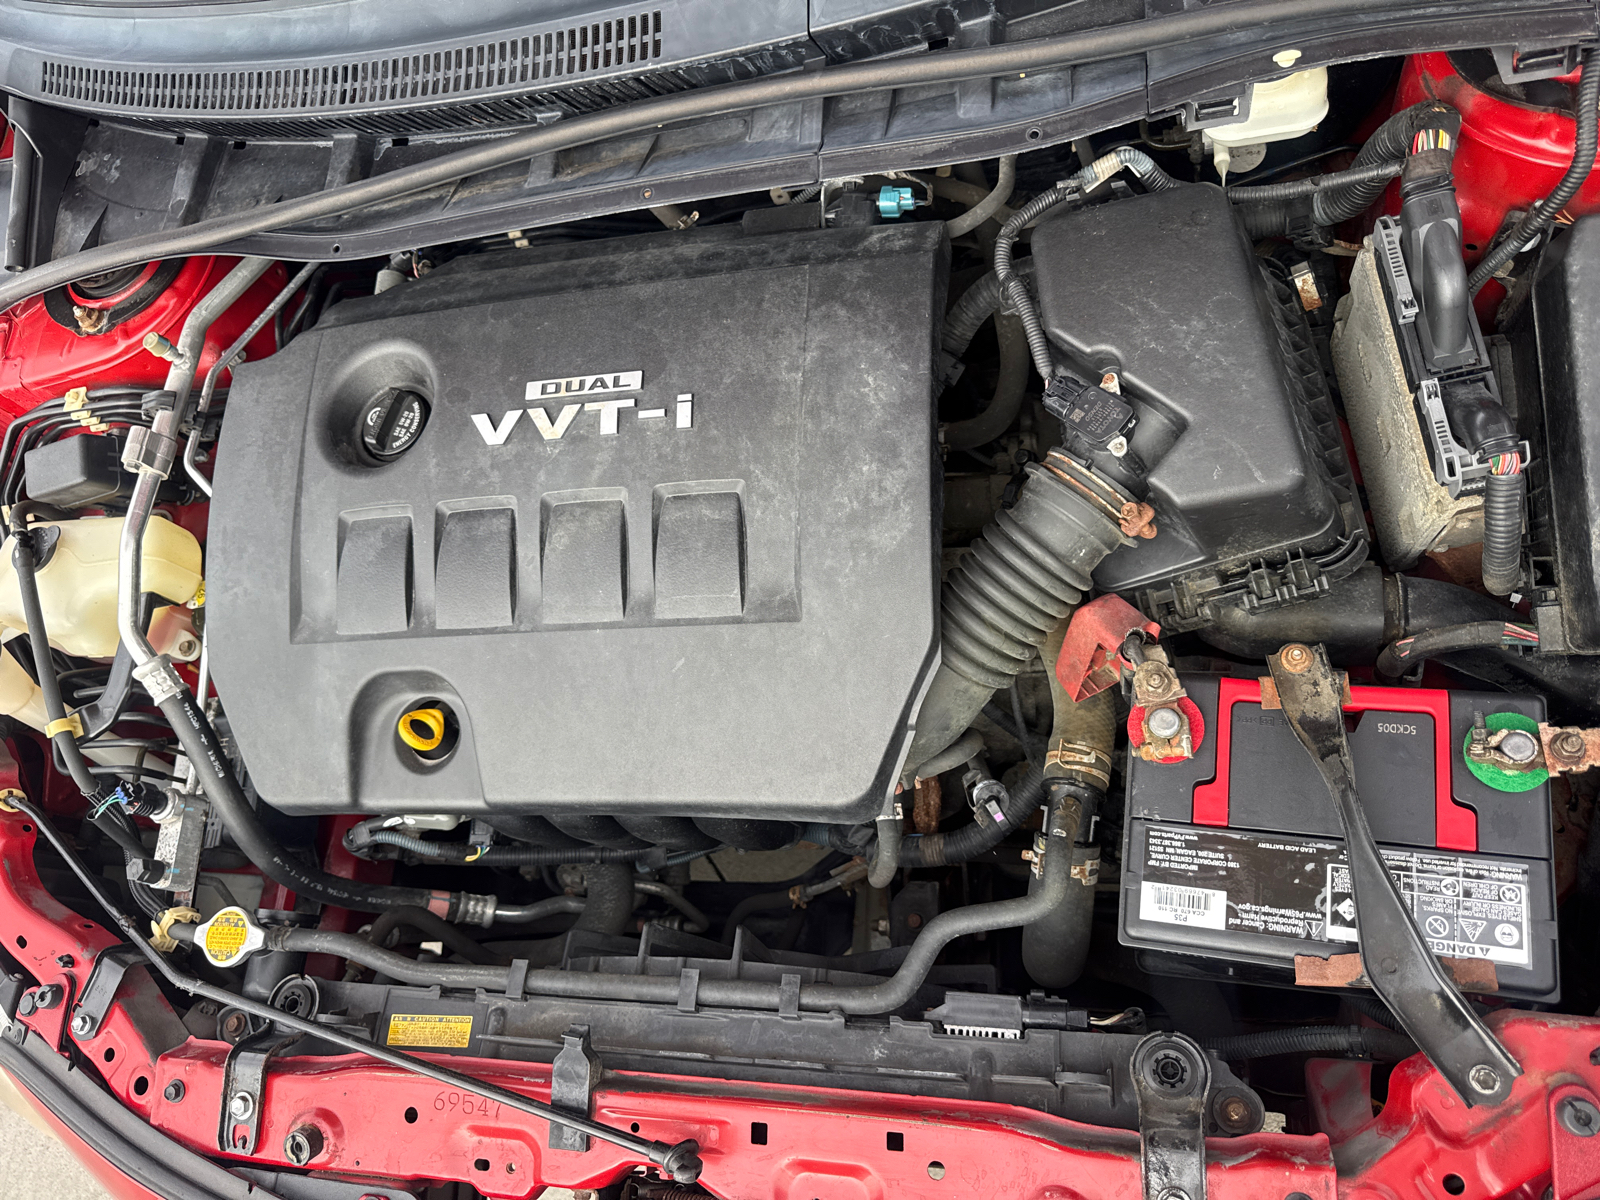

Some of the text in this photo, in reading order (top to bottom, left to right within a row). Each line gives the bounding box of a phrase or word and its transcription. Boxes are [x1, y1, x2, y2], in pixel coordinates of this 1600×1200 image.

[541, 375, 631, 395] DUAL
[1085, 401, 1102, 422] DENSO
[471, 394, 692, 445] VVT-i
[1095, 408, 1120, 434] TOYOTA
[392, 402, 420, 448] ENERGY CONSERVING
[1377, 723, 1416, 735] 5CKD05
[1258, 842, 1284, 850] BATTERY
[1150, 852, 1170, 860] CURVE,
[1170, 862, 1198, 870] IMPORTED
[1193, 858, 1226, 866] CORPORATE
[1490, 871, 1522, 881] WARNING:
[1403, 877, 1440, 886] INSTRUCTIONS
[1463, 881, 1489, 889] CHILDREN
[1238, 903, 1322, 919] www.P65Warnings.ca.gov
[1492, 904, 1522, 912] BLINDNESS
[1174, 914, 1187, 922] P35
[1457, 910, 1485, 918] EXPLOSIVE
[1242, 920, 1265, 929] Cancer
[1261, 915, 1303, 926] Reproductive
[1266, 923, 1304, 934] WARNING:
[1428, 941, 1475, 955] DANGE
